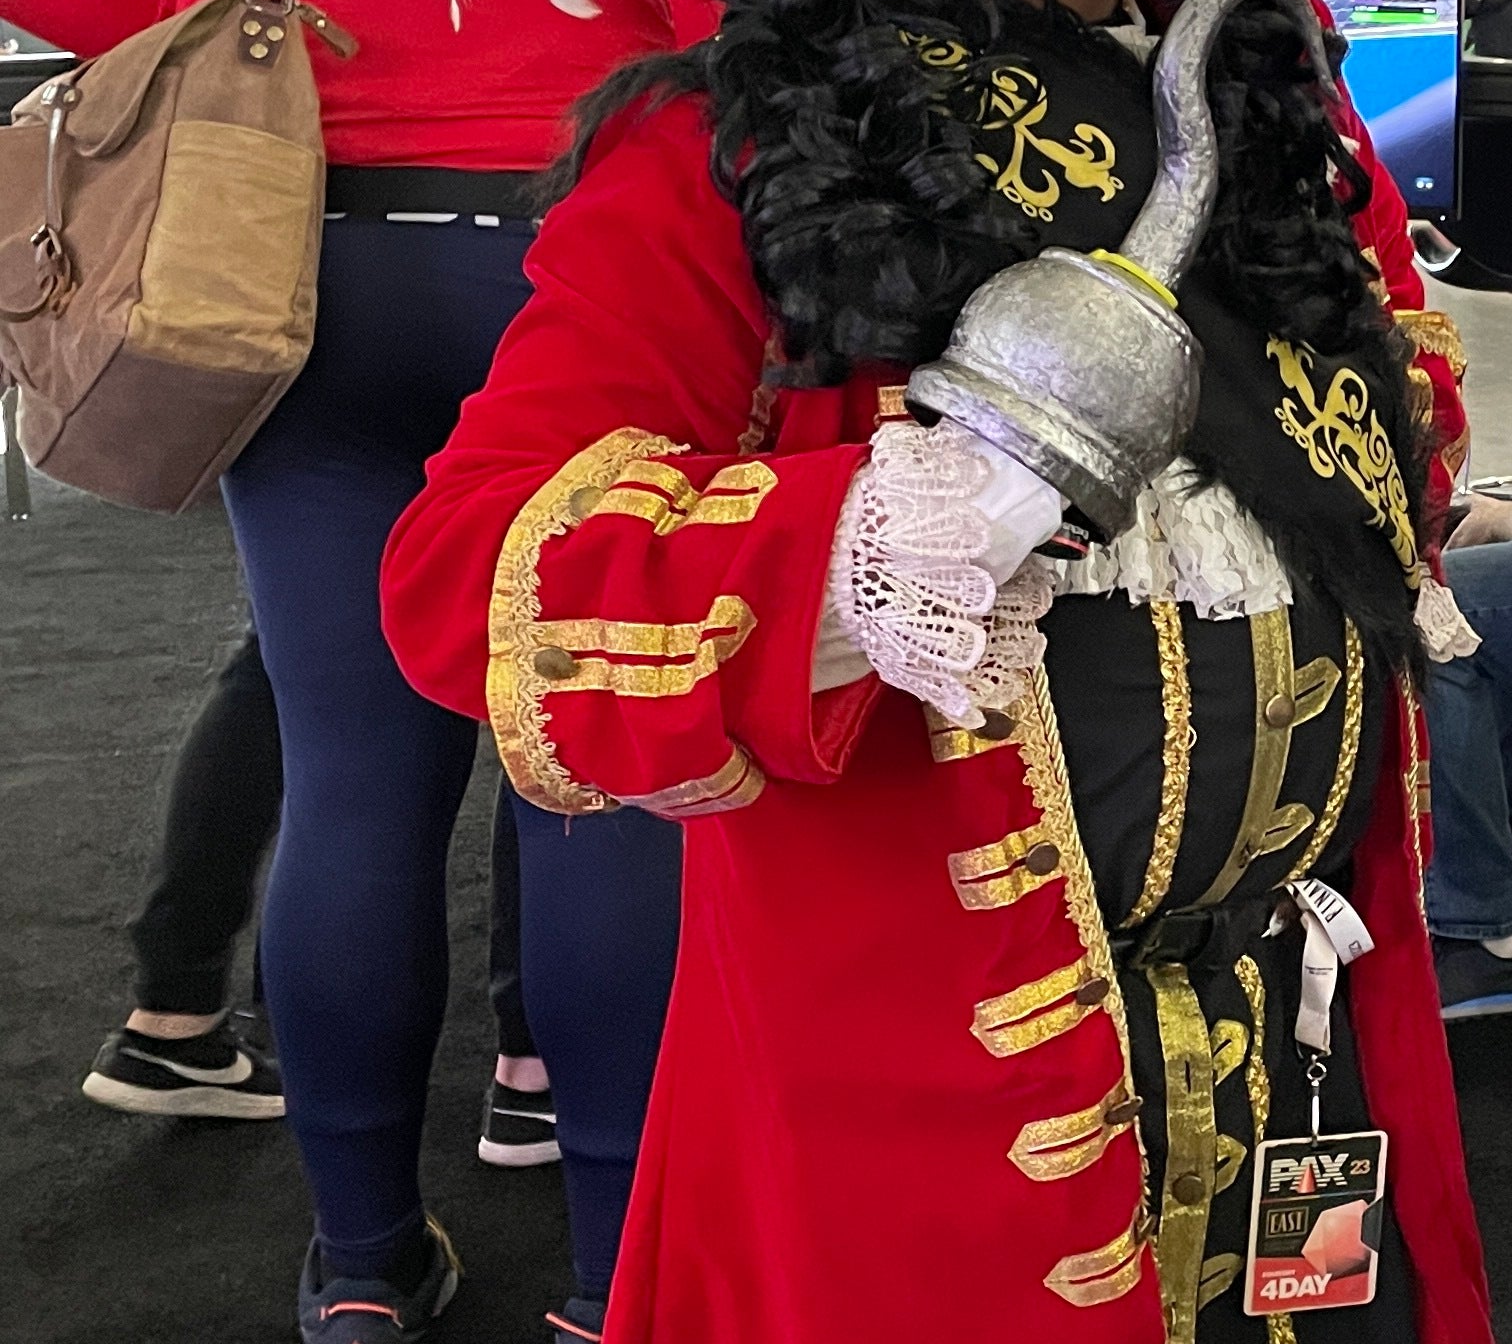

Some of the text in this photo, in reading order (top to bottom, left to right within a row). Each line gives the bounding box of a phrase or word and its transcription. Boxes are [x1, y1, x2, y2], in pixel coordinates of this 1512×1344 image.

[1268, 1153, 1350, 1194] PAX
[1270, 1210, 1305, 1235] EAST
[1260, 1273, 1332, 1301] 4DAY
